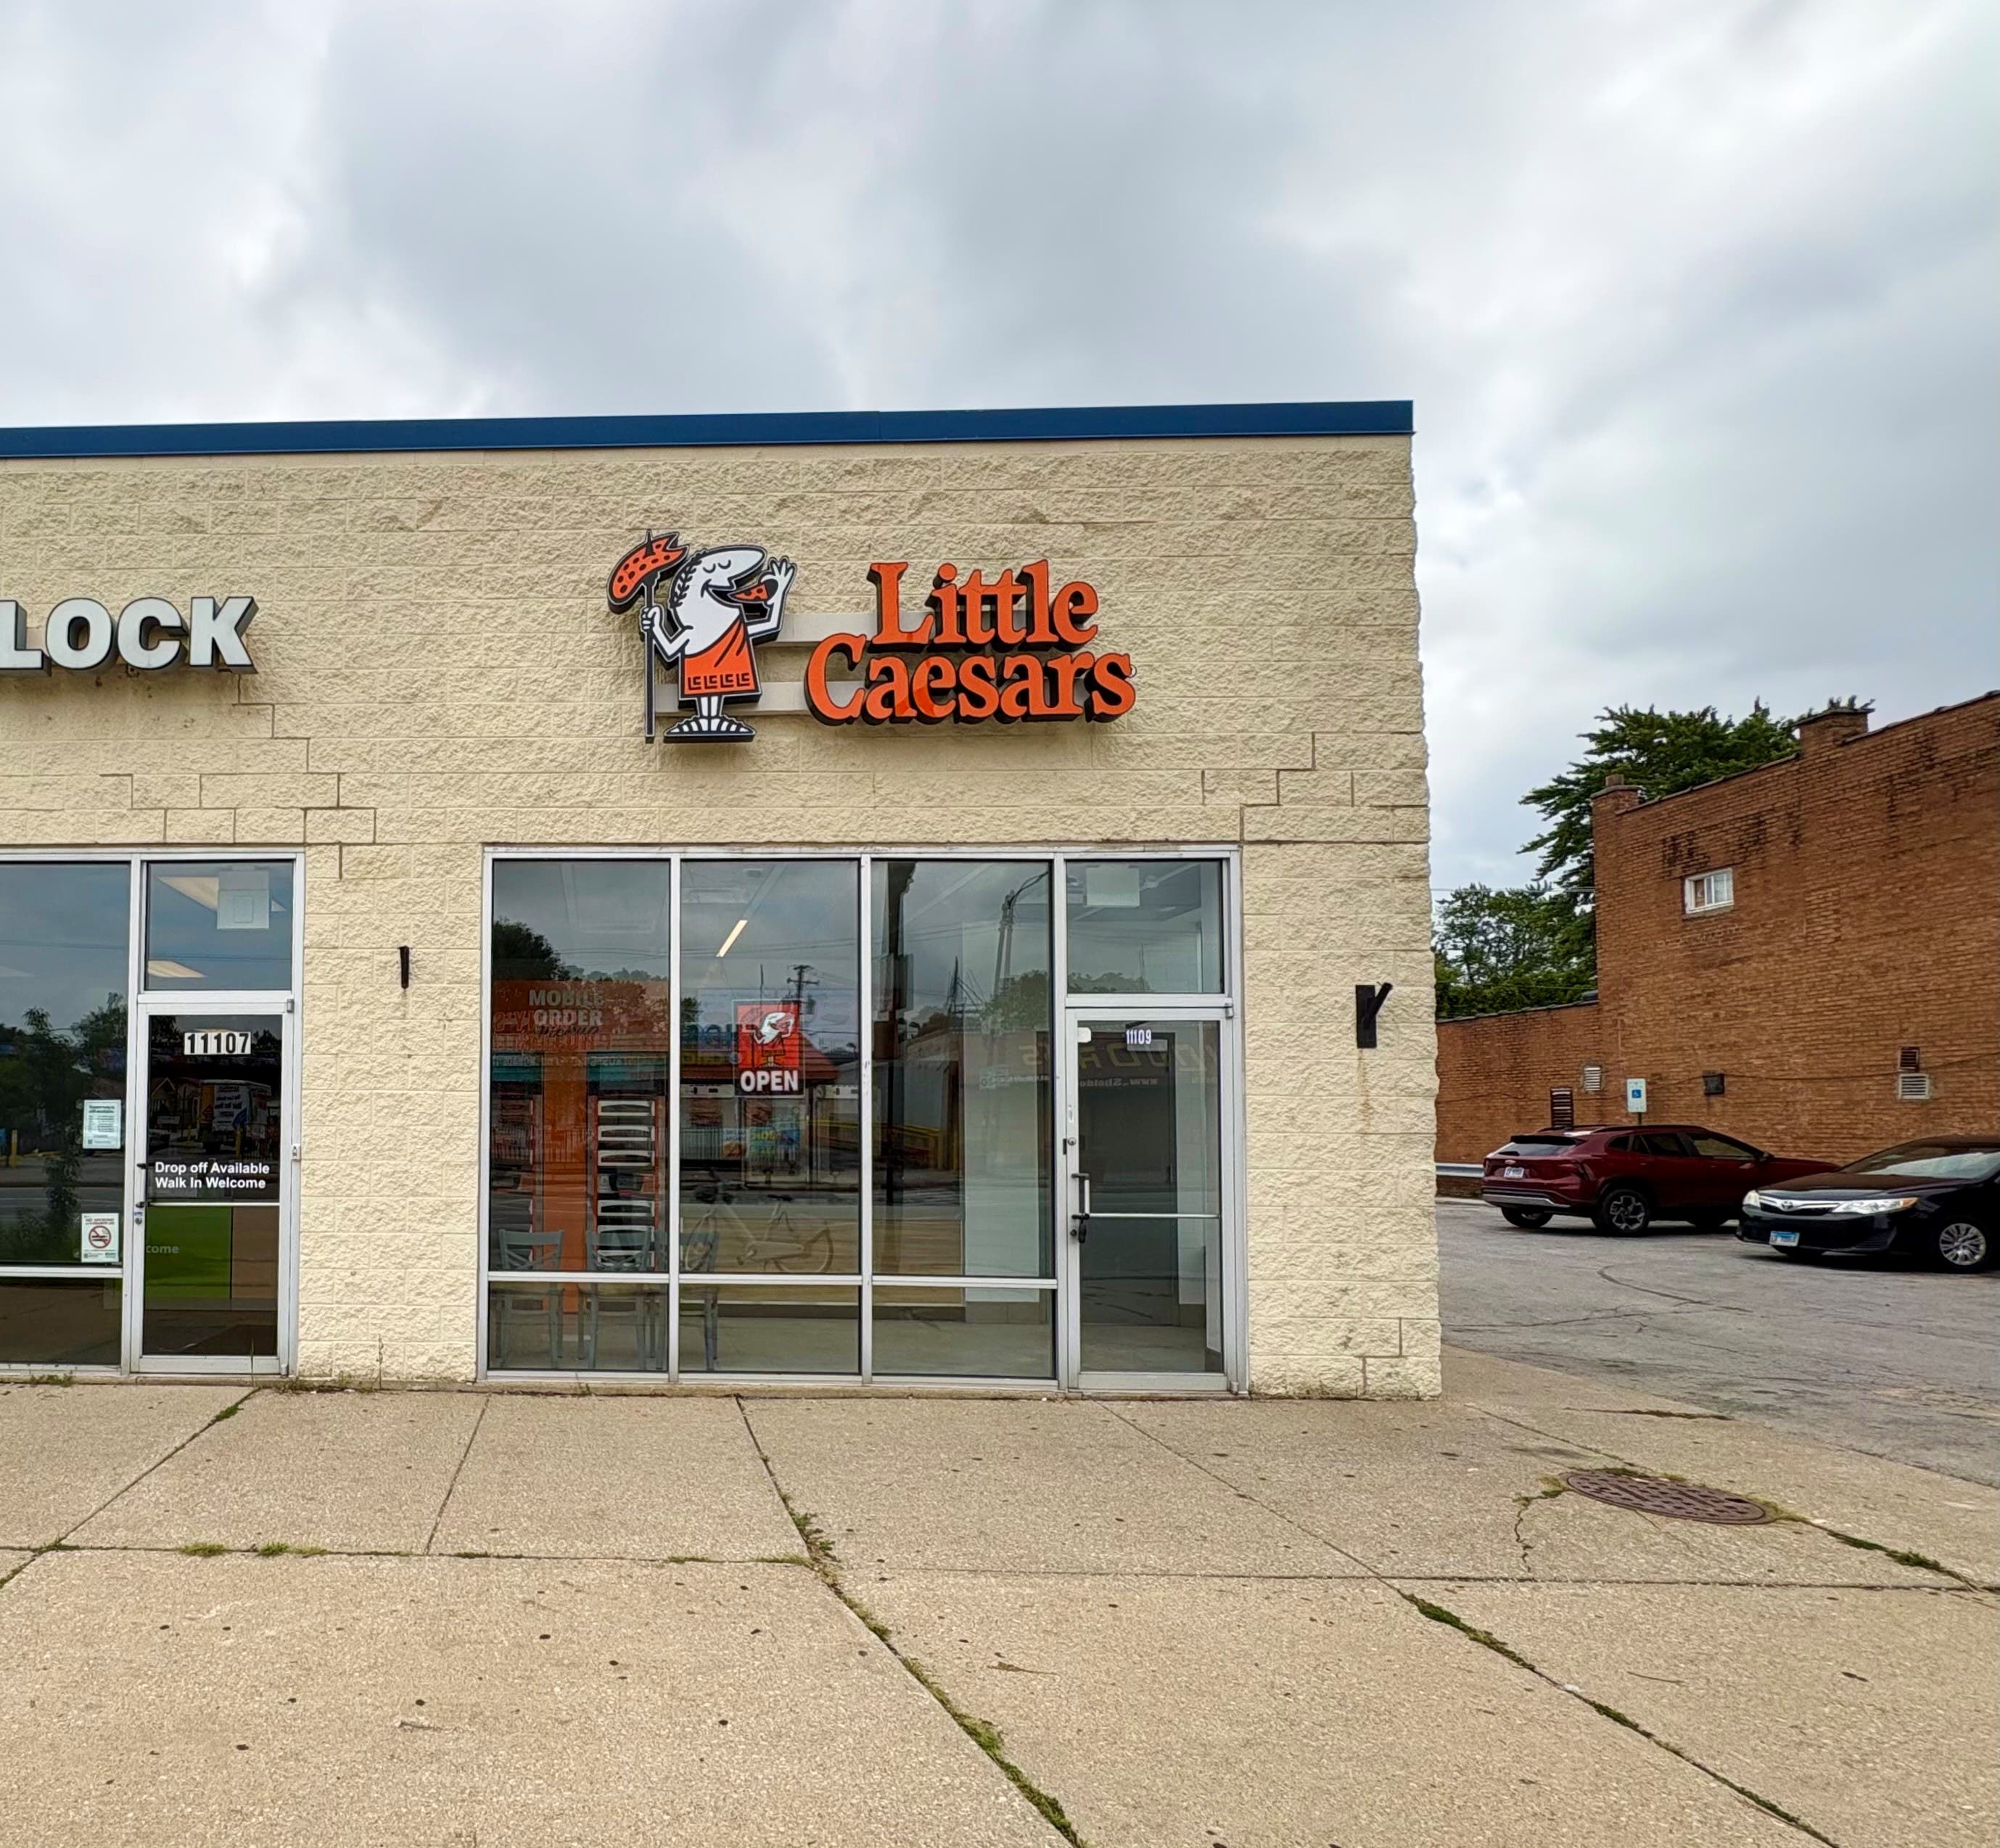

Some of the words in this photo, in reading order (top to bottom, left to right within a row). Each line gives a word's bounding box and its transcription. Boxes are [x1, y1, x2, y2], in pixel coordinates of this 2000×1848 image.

[869, 559, 1100, 648] Little
[0, 596, 258, 673] LOCK
[804, 634, 1136, 722] Caesars
[529, 989, 604, 1007] MOBILE
[533, 1009, 604, 1026] ORDER
[187, 1032, 250, 1054] 11107
[1126, 1029, 1152, 1045] 11109
[740, 1070, 799, 1092] OPEN
[155, 1161, 186, 1175] Drop
[190, 1161, 208, 1173] off
[210, 1162, 270, 1174] Available
[155, 1176, 186, 1188] Walk
[190, 1178, 202, 1188] In
[206, 1176, 266, 1189] Welcome
